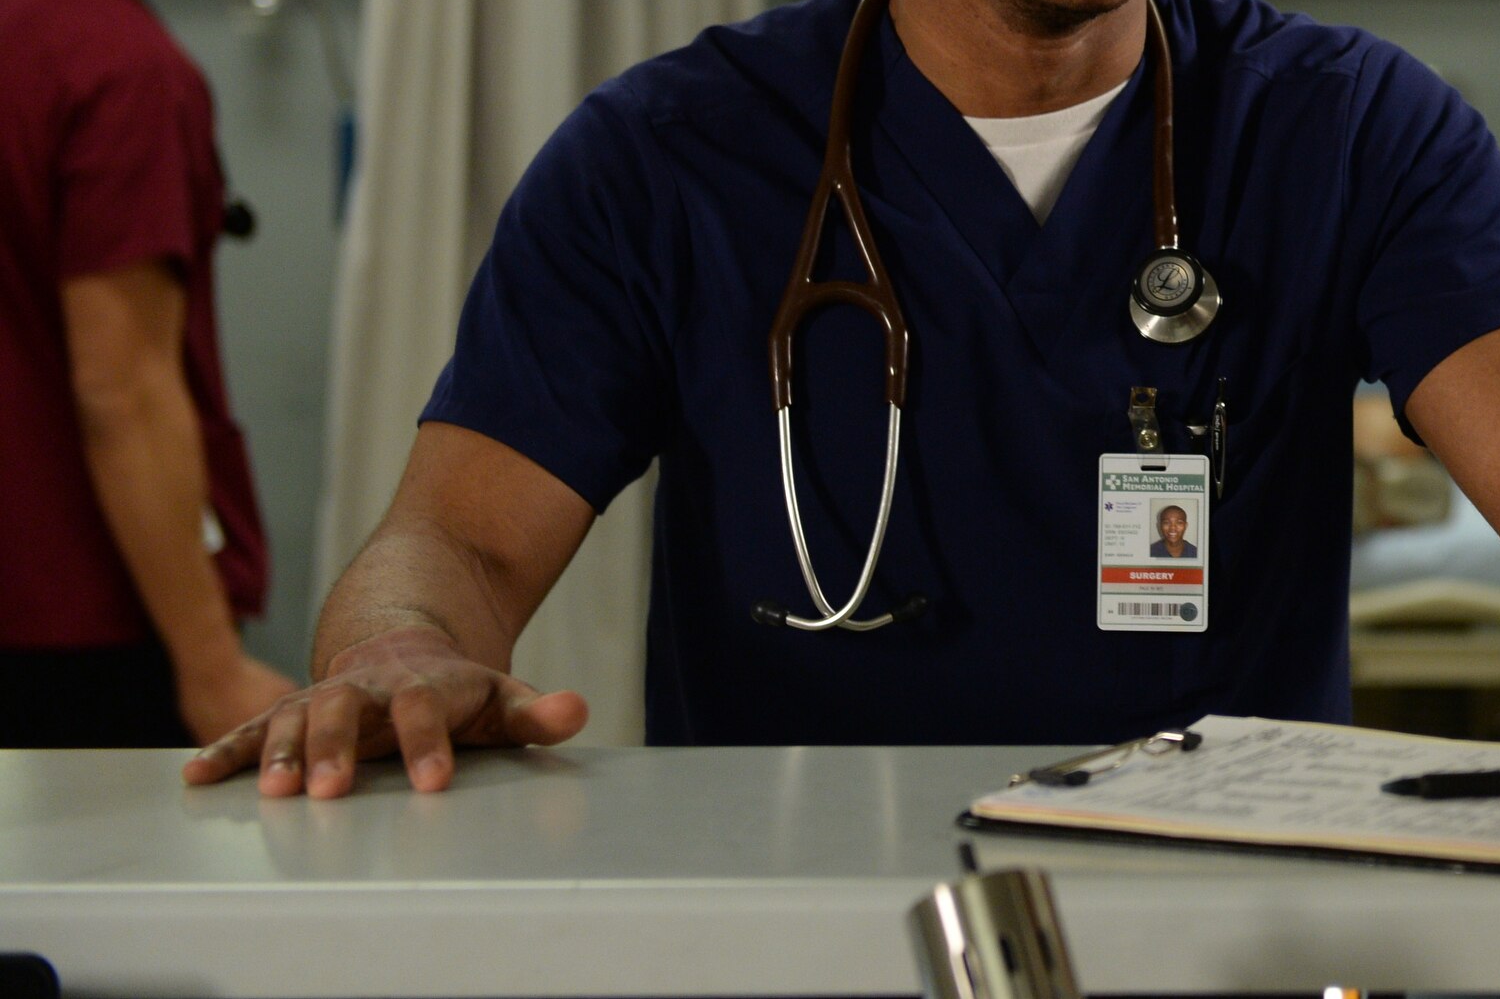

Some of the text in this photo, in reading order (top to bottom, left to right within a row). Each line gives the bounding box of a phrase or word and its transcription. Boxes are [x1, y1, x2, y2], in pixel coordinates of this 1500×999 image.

[1122, 474, 1179, 483] SAN ANTONIO
[1122, 482, 1205, 492] MEMORIAL HOSPITAL
[1129, 572, 1175, 580] SURGERY
